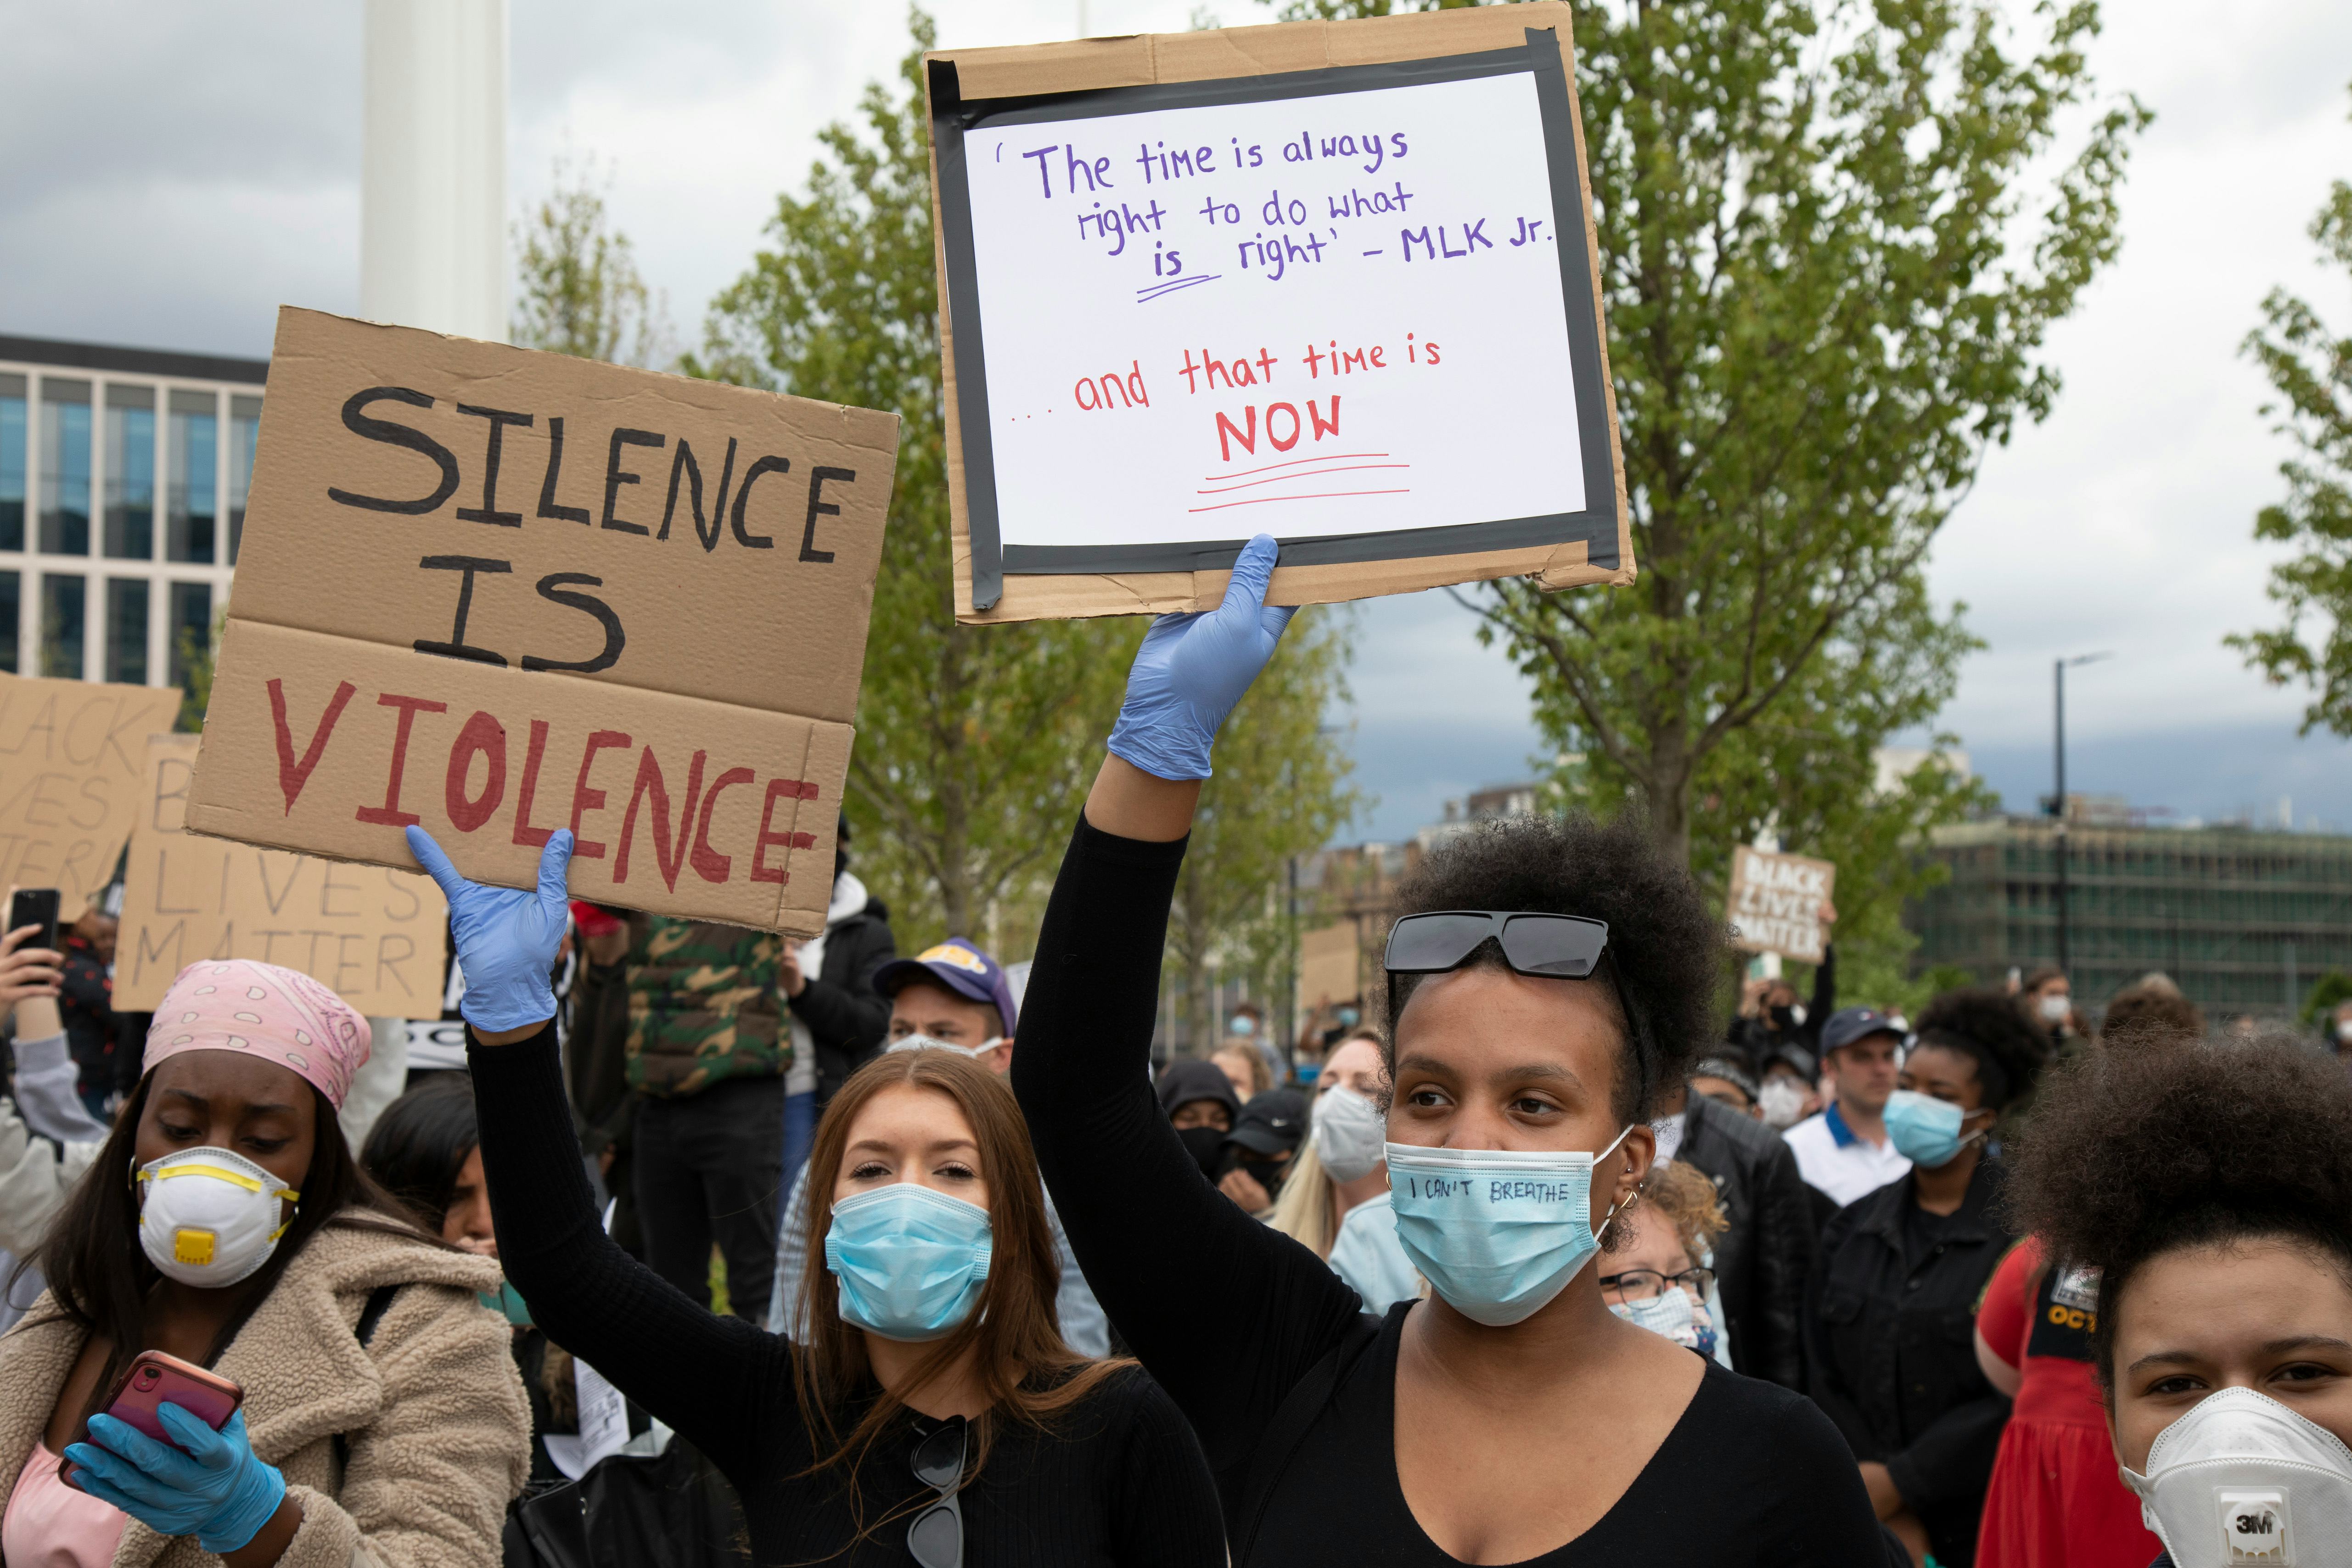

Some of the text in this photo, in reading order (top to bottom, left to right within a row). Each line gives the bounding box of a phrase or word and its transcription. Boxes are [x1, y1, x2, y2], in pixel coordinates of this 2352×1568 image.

[1231, 137, 1263, 169] is
[1283, 131, 1408, 174] always
[1078, 182, 1414, 256] right to do what
[1154, 240, 1182, 276] is
[1400, 218, 1493, 263] MLK
[1509, 216, 1553, 247] Jr.
[1178, 347, 1279, 394] that
[1407, 332, 1441, 365] is
[1215, 395, 1342, 461] NOW
[327, 386, 856, 563] SILENCE
[412, 555, 625, 674] IS
[266, 678, 820, 894] VIOLENCE
[156, 848, 421, 922] LIVES
[1746, 854, 1826, 897] BLACK
[133, 919, 415, 998] MATTER
[1409, 1177, 1569, 1204] I CAN'T BREATHE
[2236, 1511, 2273, 1534] 3M
